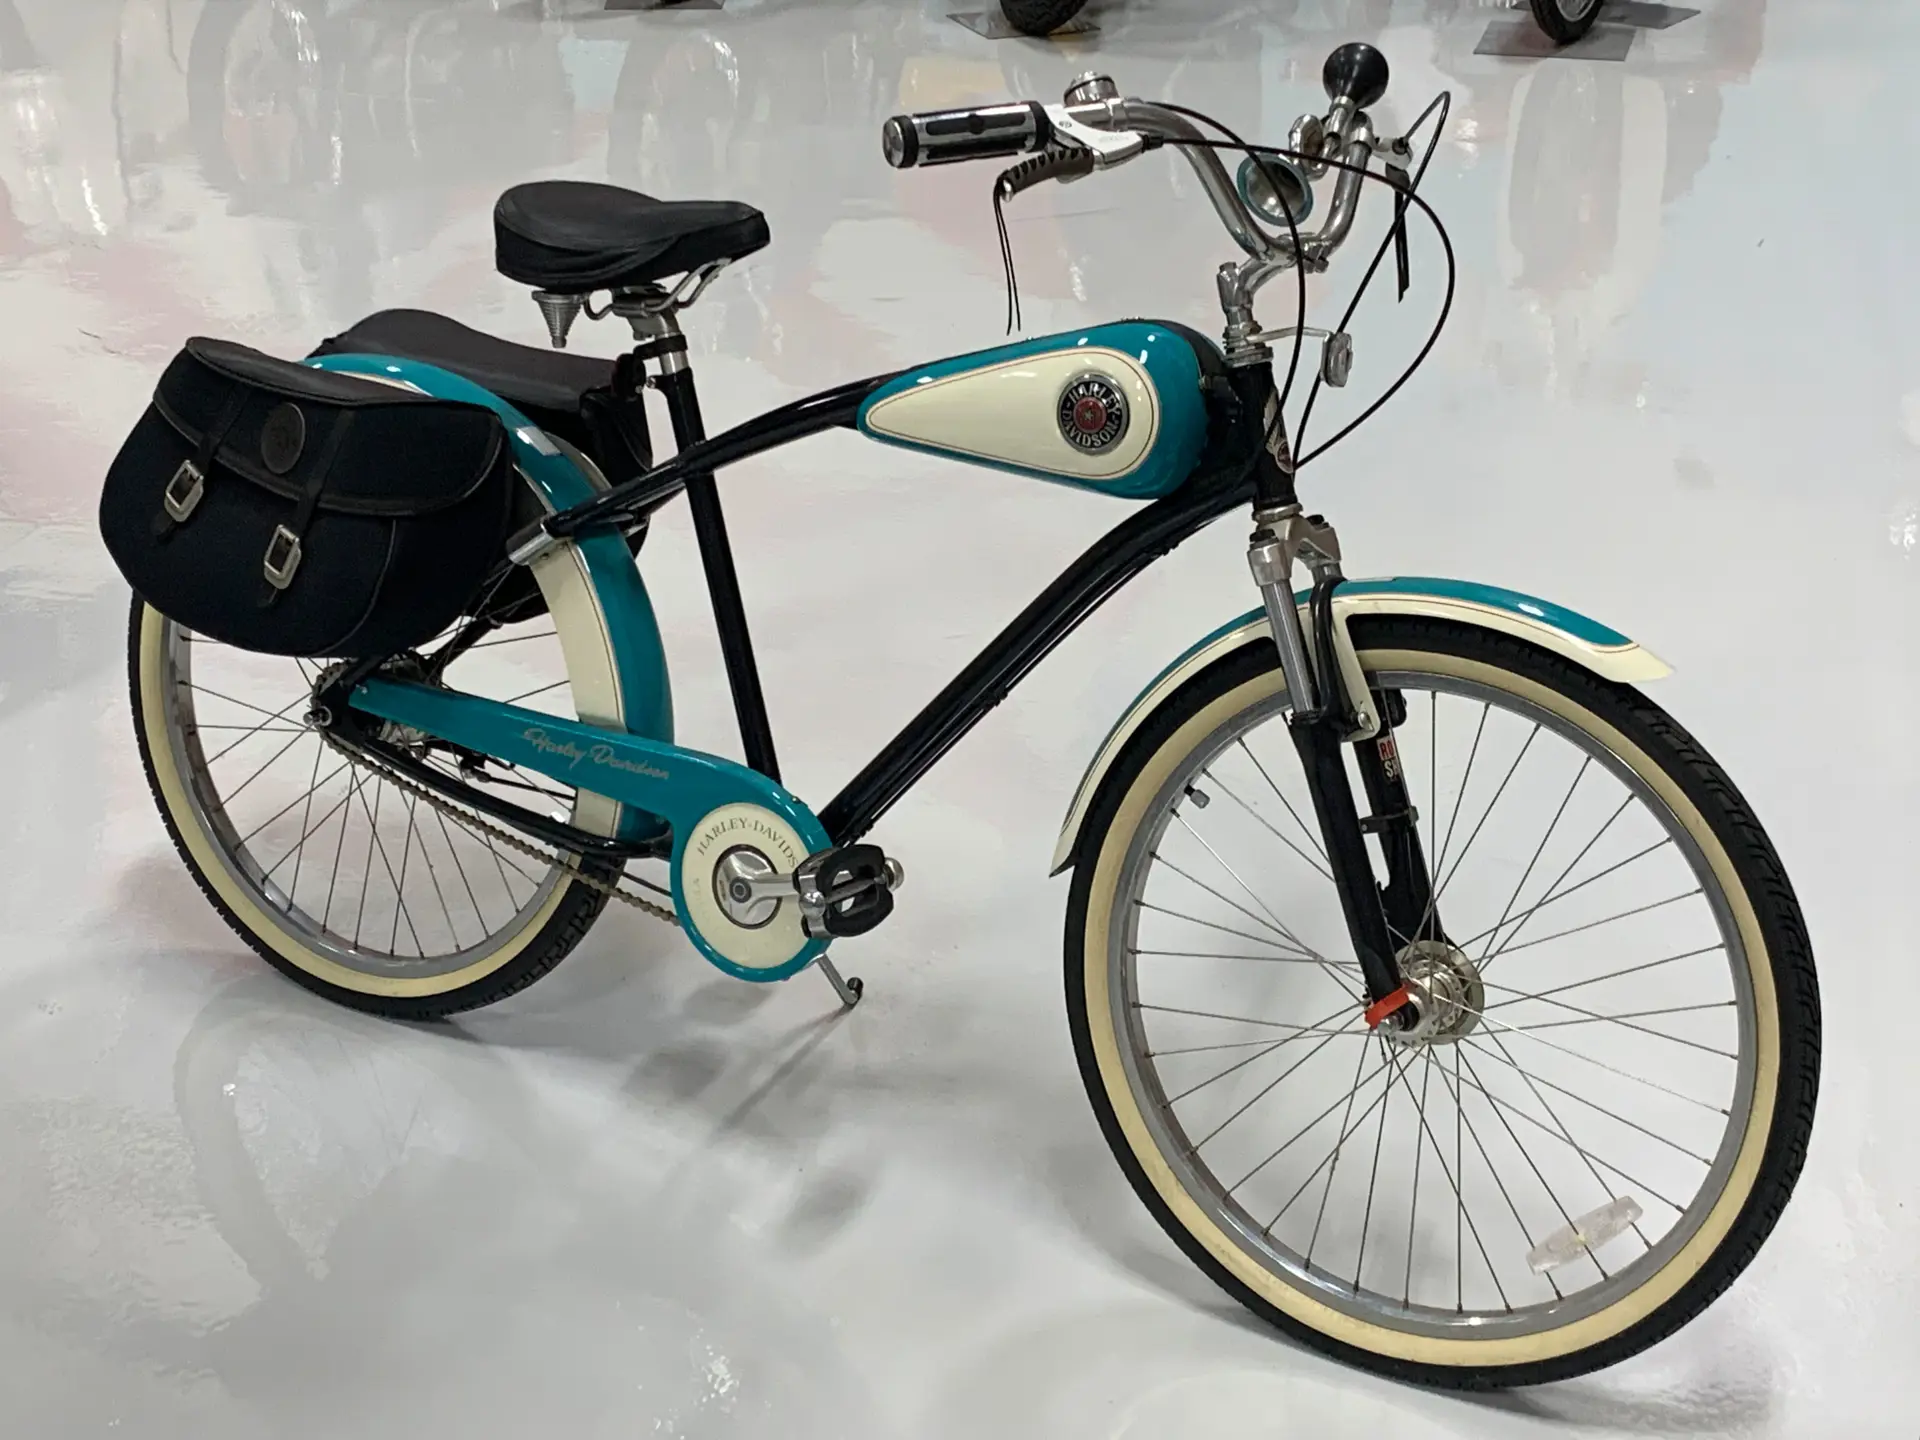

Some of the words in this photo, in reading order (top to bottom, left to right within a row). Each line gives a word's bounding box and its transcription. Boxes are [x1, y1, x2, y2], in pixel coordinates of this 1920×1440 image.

[1068, 382, 1121, 415] HARLEY
[1062, 409, 1120, 447] DAVIDSON
[696, 816, 800, 869] HARLEY-DAVIDS
